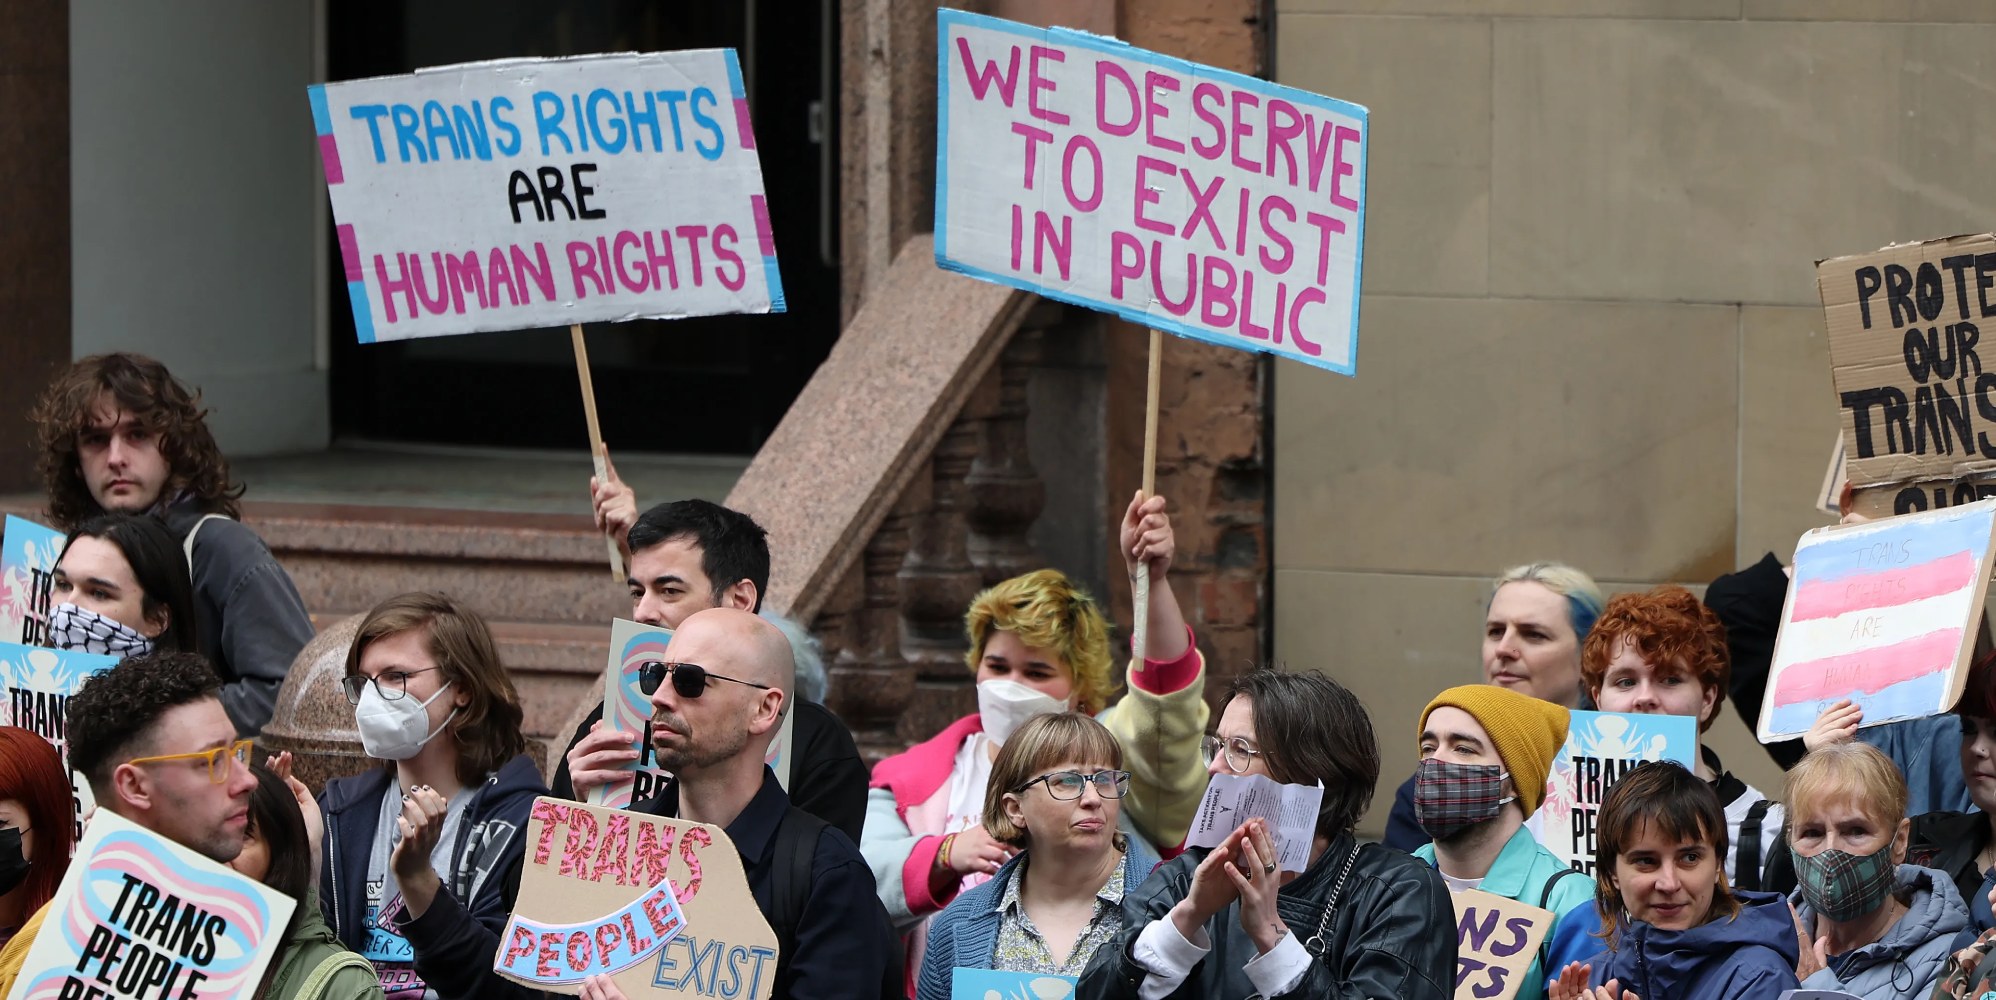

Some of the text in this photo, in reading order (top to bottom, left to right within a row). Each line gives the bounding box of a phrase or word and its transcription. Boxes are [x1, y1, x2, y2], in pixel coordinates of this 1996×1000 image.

[350, 88, 725, 164] TRANS RIGHTS
[957, 37, 1361, 213] WE DESERVE
[508, 163, 606, 224] ARE
[1011, 122, 1346, 286] TO EXIST
[373, 223, 746, 324] HUMAN RIGHTS
[1011, 204, 1327, 357] IN PUBLIC
[1855, 252, 1996, 329] PROTE
[1903, 321, 1982, 384] OUR
[1850, 538, 1913, 569] TRANS
[1850, 615, 1885, 641] ARE
[531, 801, 712, 904] TRANS
[1206, 810, 1215, 831] TRANS
[108, 872, 226, 967] TRANS
[503, 889, 678, 977] PEOPLE
[1458, 906, 1534, 957] NS
[652, 934, 776, 1000] EXIST
